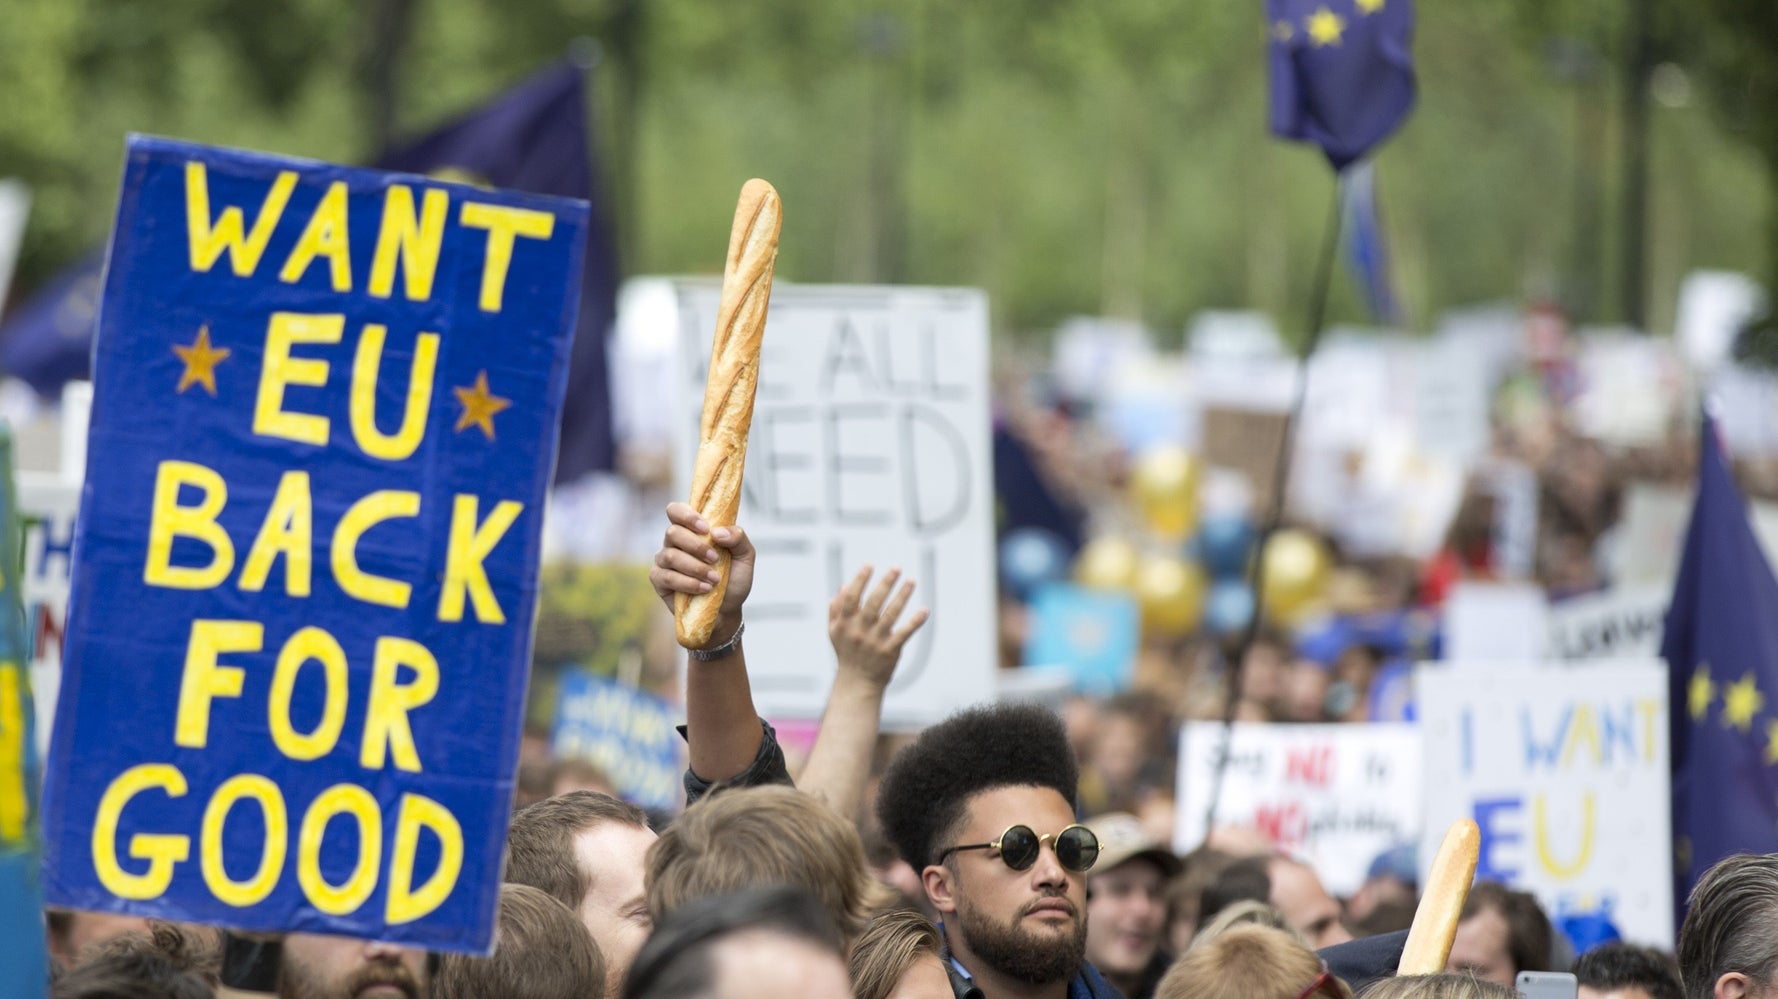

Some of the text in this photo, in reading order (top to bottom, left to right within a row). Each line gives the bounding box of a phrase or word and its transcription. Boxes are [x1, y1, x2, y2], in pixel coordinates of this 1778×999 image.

[186, 162, 555, 312] WANT
[252, 312, 441, 461] EU
[817, 311, 973, 401] ALL
[144, 460, 524, 624] BACK
[175, 620, 440, 773] FOR
[1459, 700, 1660, 775] I WANT
[92, 763, 464, 925] GOOD
[1472, 793, 1596, 883] EU
